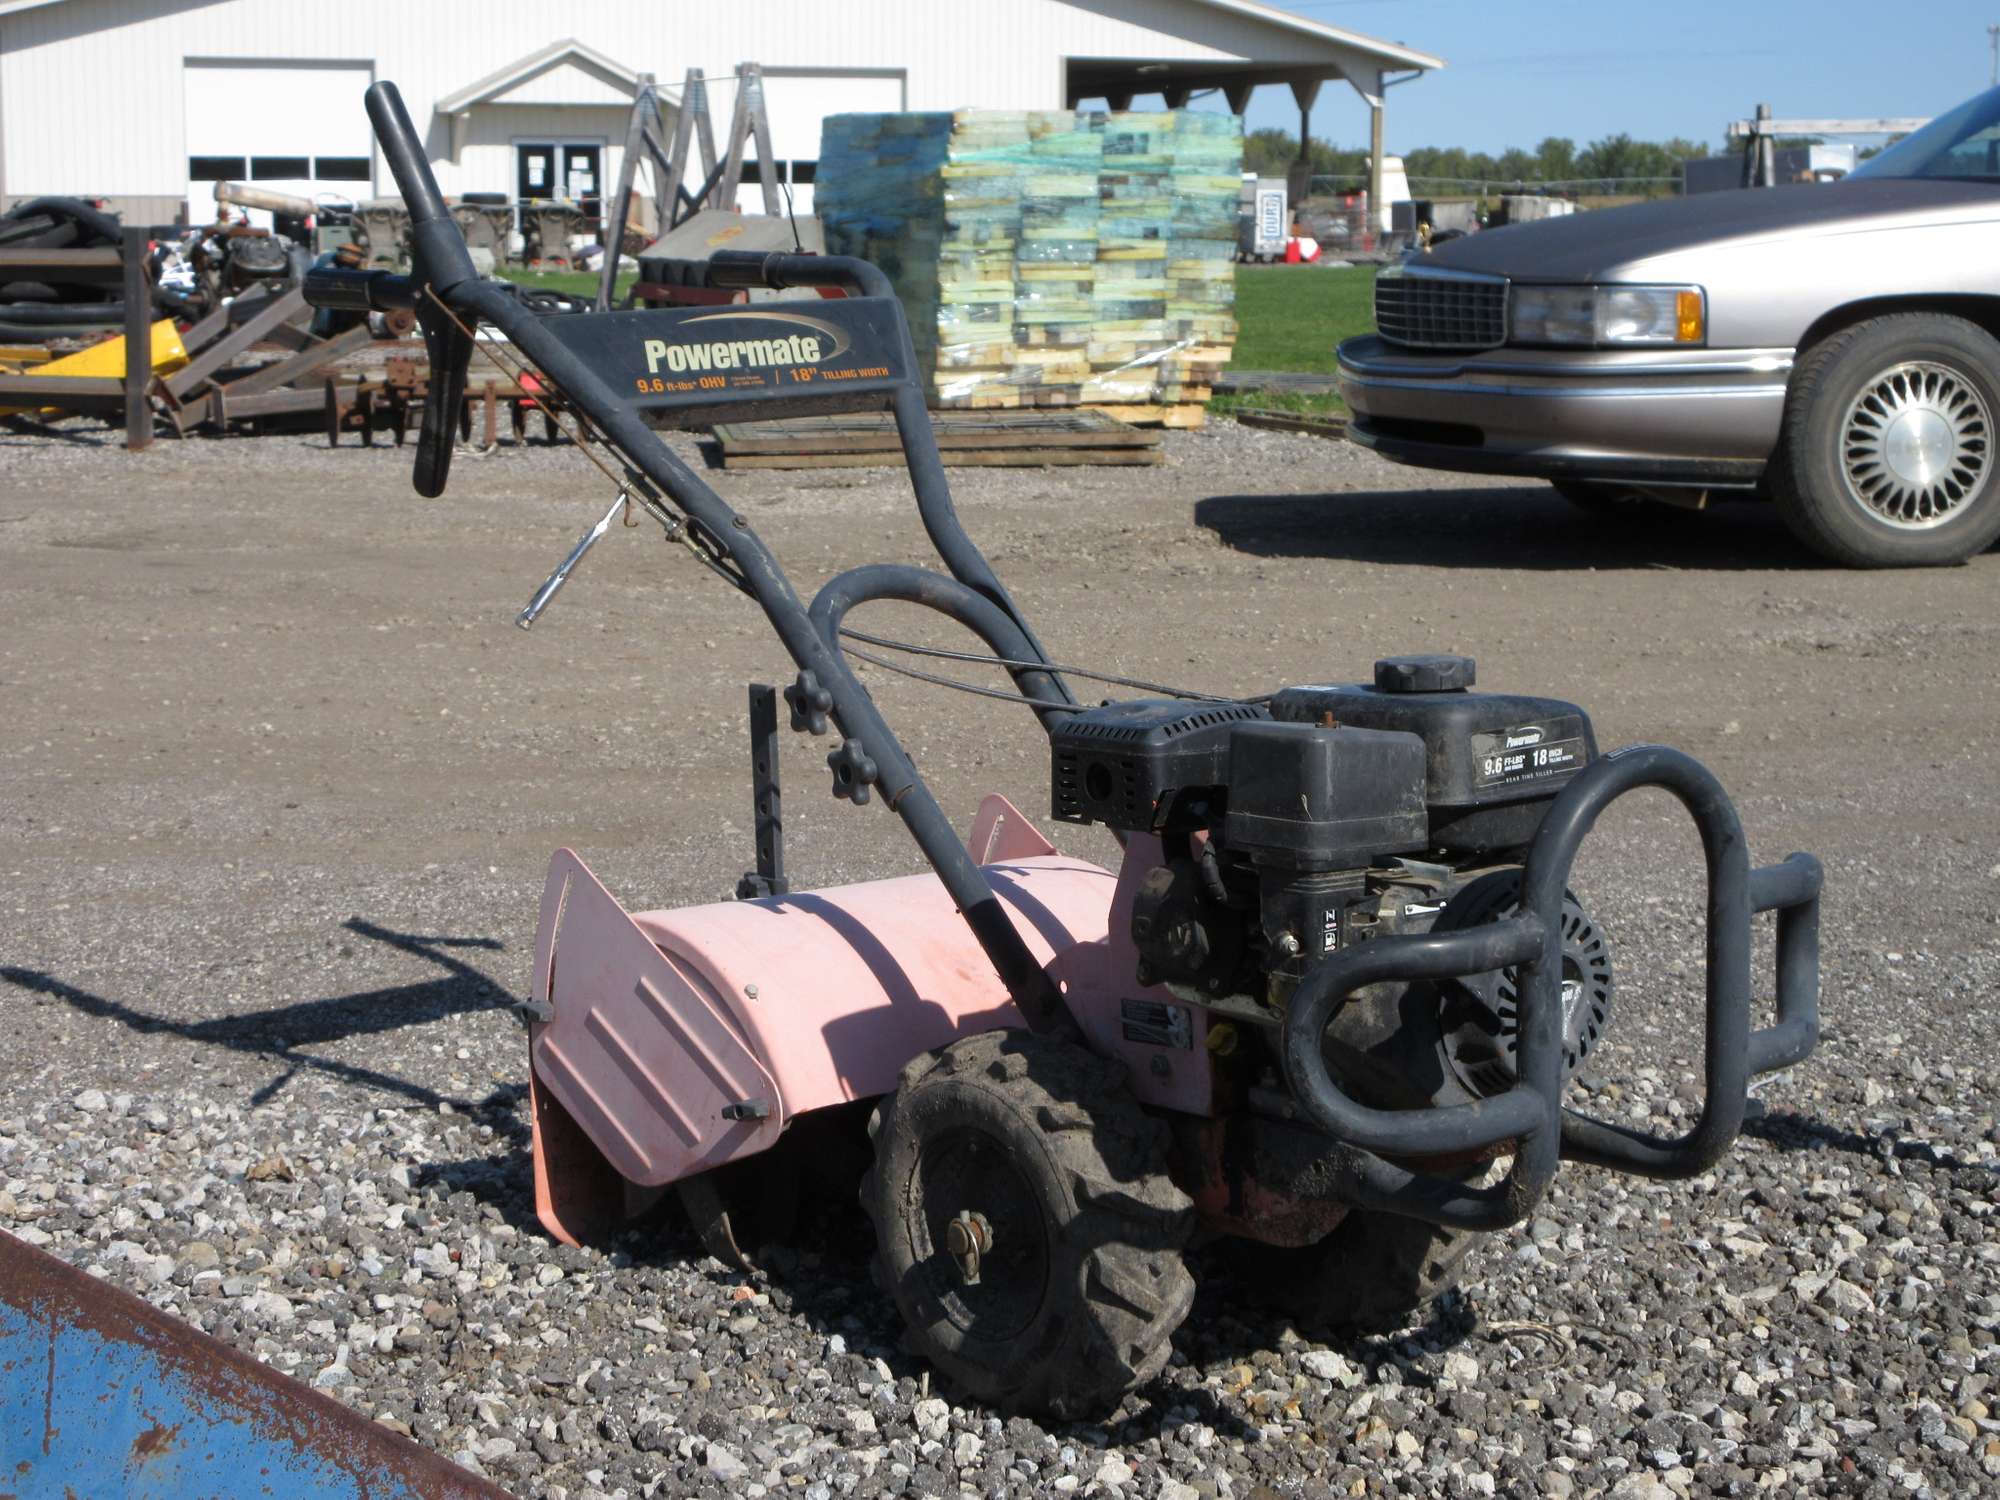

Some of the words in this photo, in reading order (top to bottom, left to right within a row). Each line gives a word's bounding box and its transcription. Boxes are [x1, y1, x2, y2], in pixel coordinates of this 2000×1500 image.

[644, 334, 821, 373] Powermate
[637, 378, 664, 393] 9.6
[699, 376, 726, 389] OHV
[821, 370, 858, 380] TILLING
[858, 367, 890, 377] WIDTH
[1484, 757, 1503, 775] 9.6
[1533, 749, 1548, 766] 18
